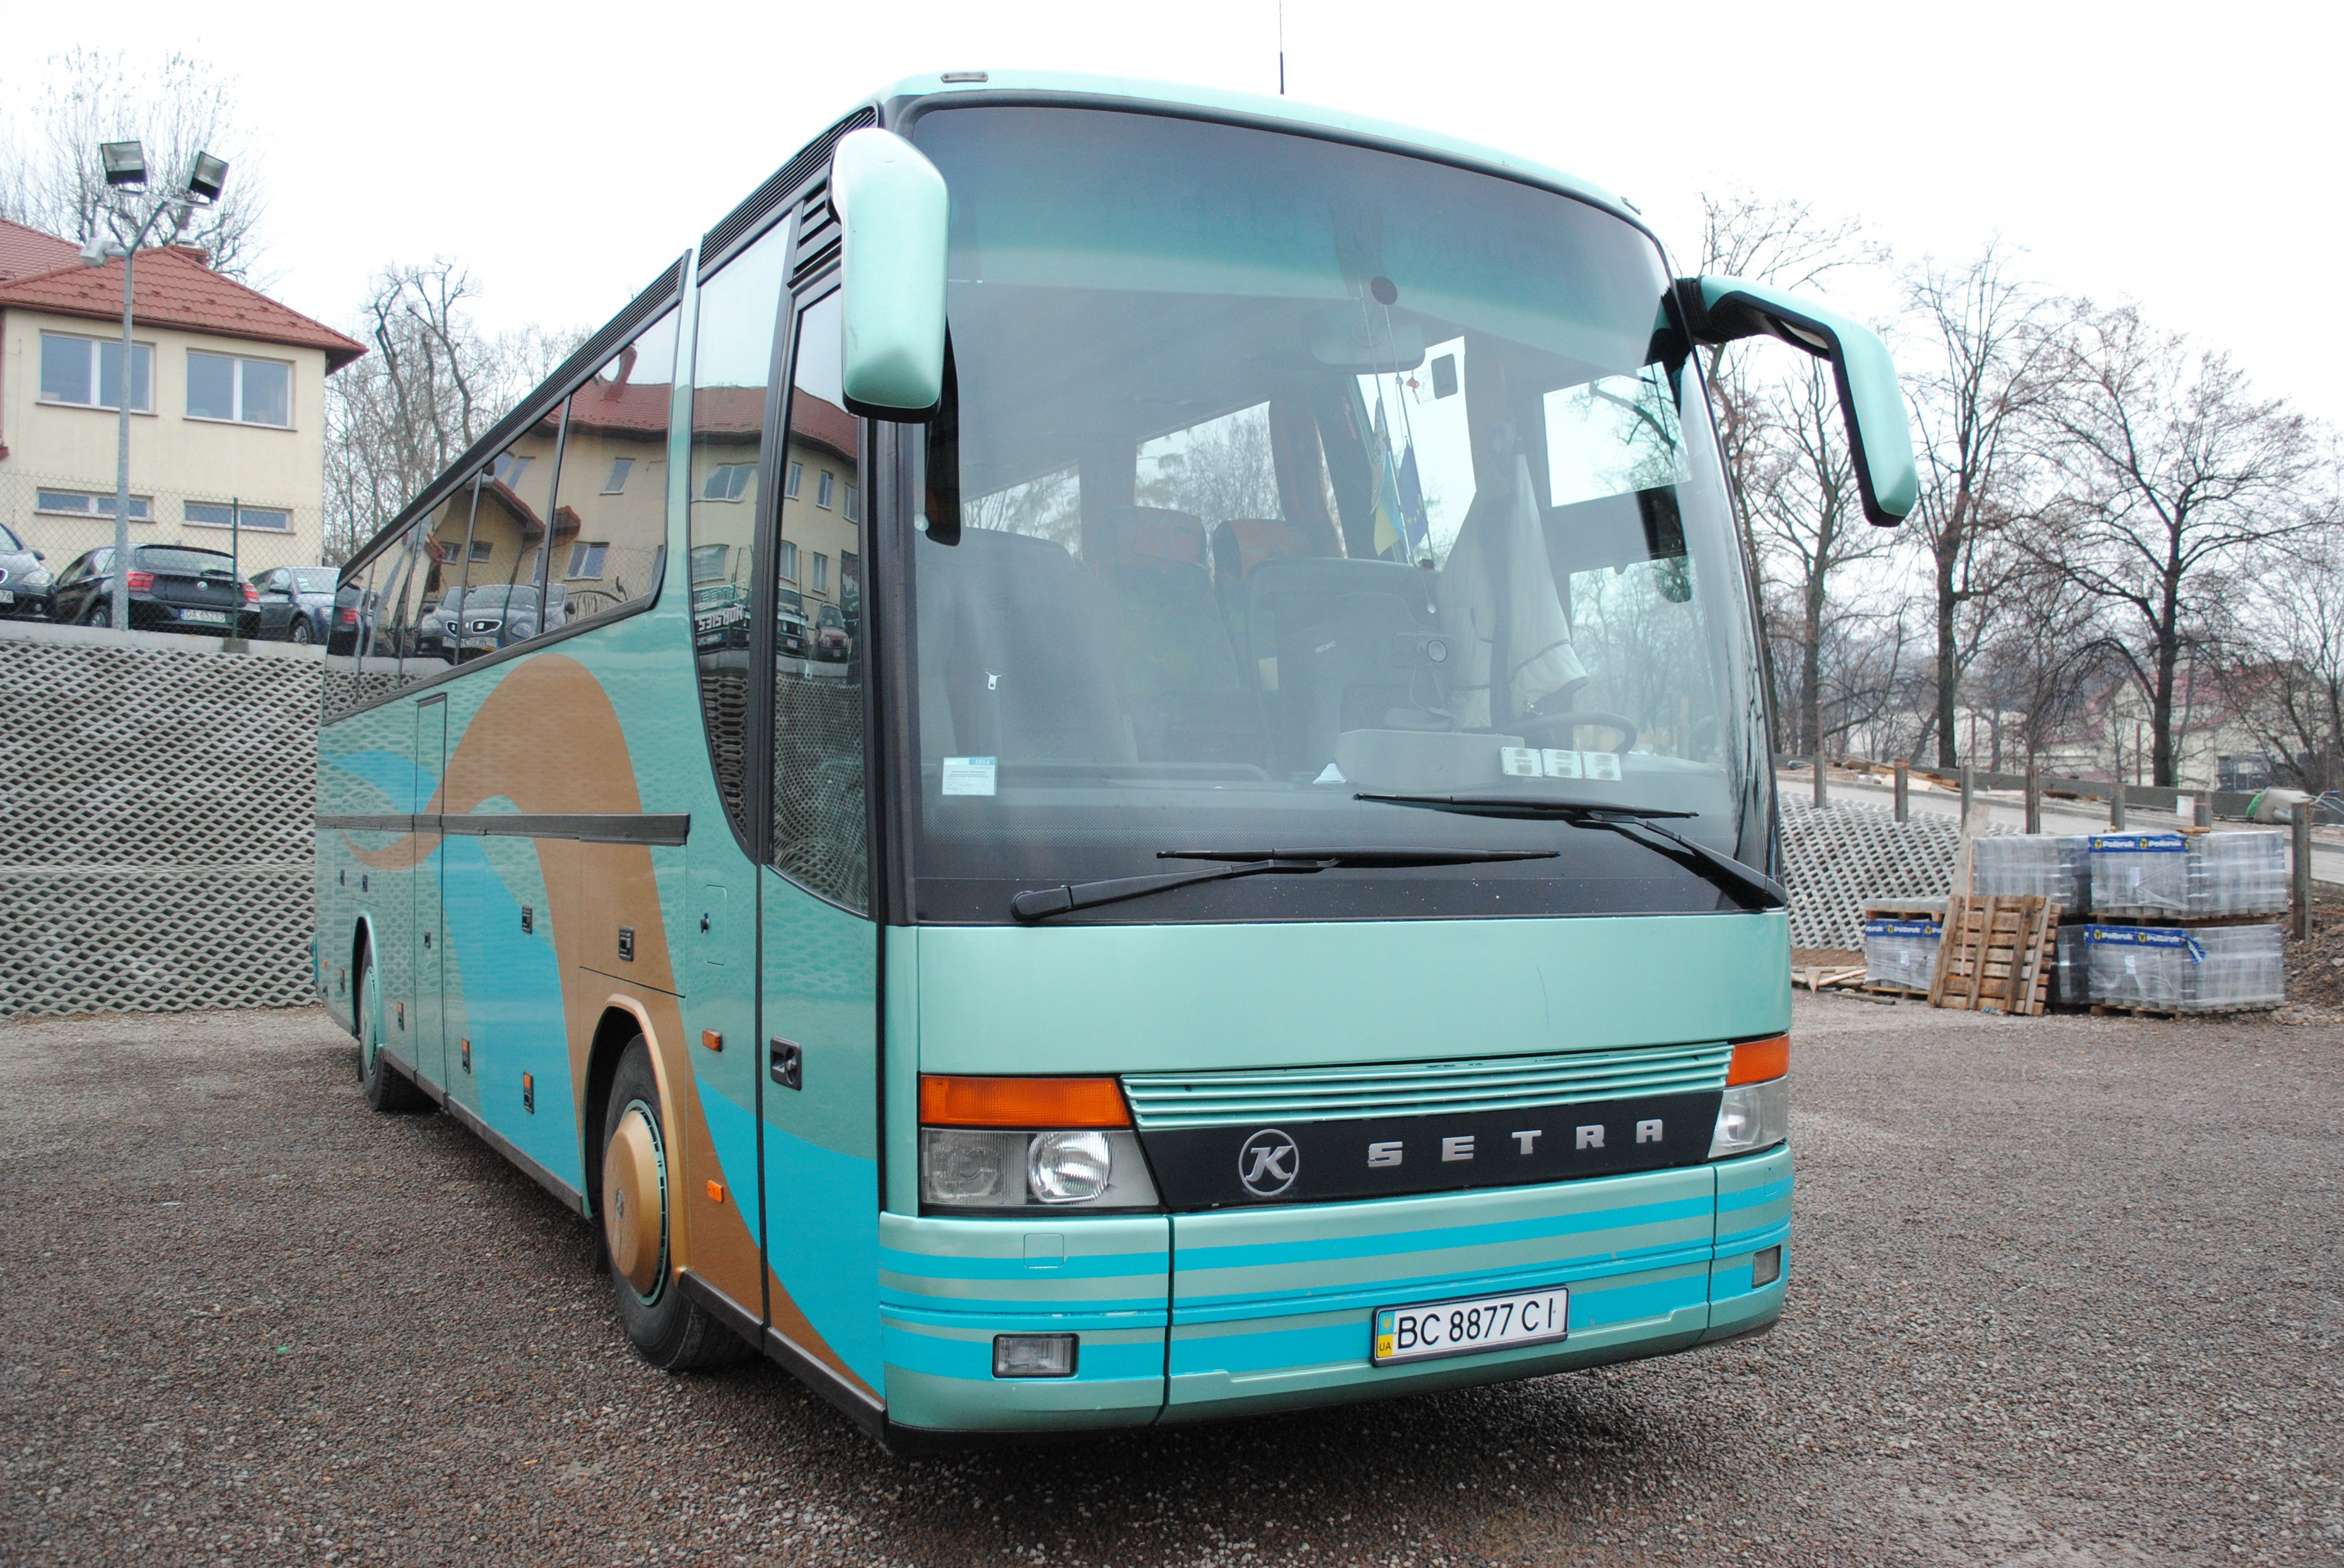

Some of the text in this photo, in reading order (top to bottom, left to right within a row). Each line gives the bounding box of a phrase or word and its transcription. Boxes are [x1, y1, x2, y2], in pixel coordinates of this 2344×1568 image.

[2103, 840, 2135, 848] Polbruk
[2148, 840, 2182, 848] Polbruk
[2101, 931, 2134, 941] Polbruk
[2147, 933, 2180, 943] Polbruk
[1368, 1119, 1663, 1167] SETRA
[1398, 1297, 1559, 1349] BC 8877 CI
[1379, 1341, 1392, 1352] UA
